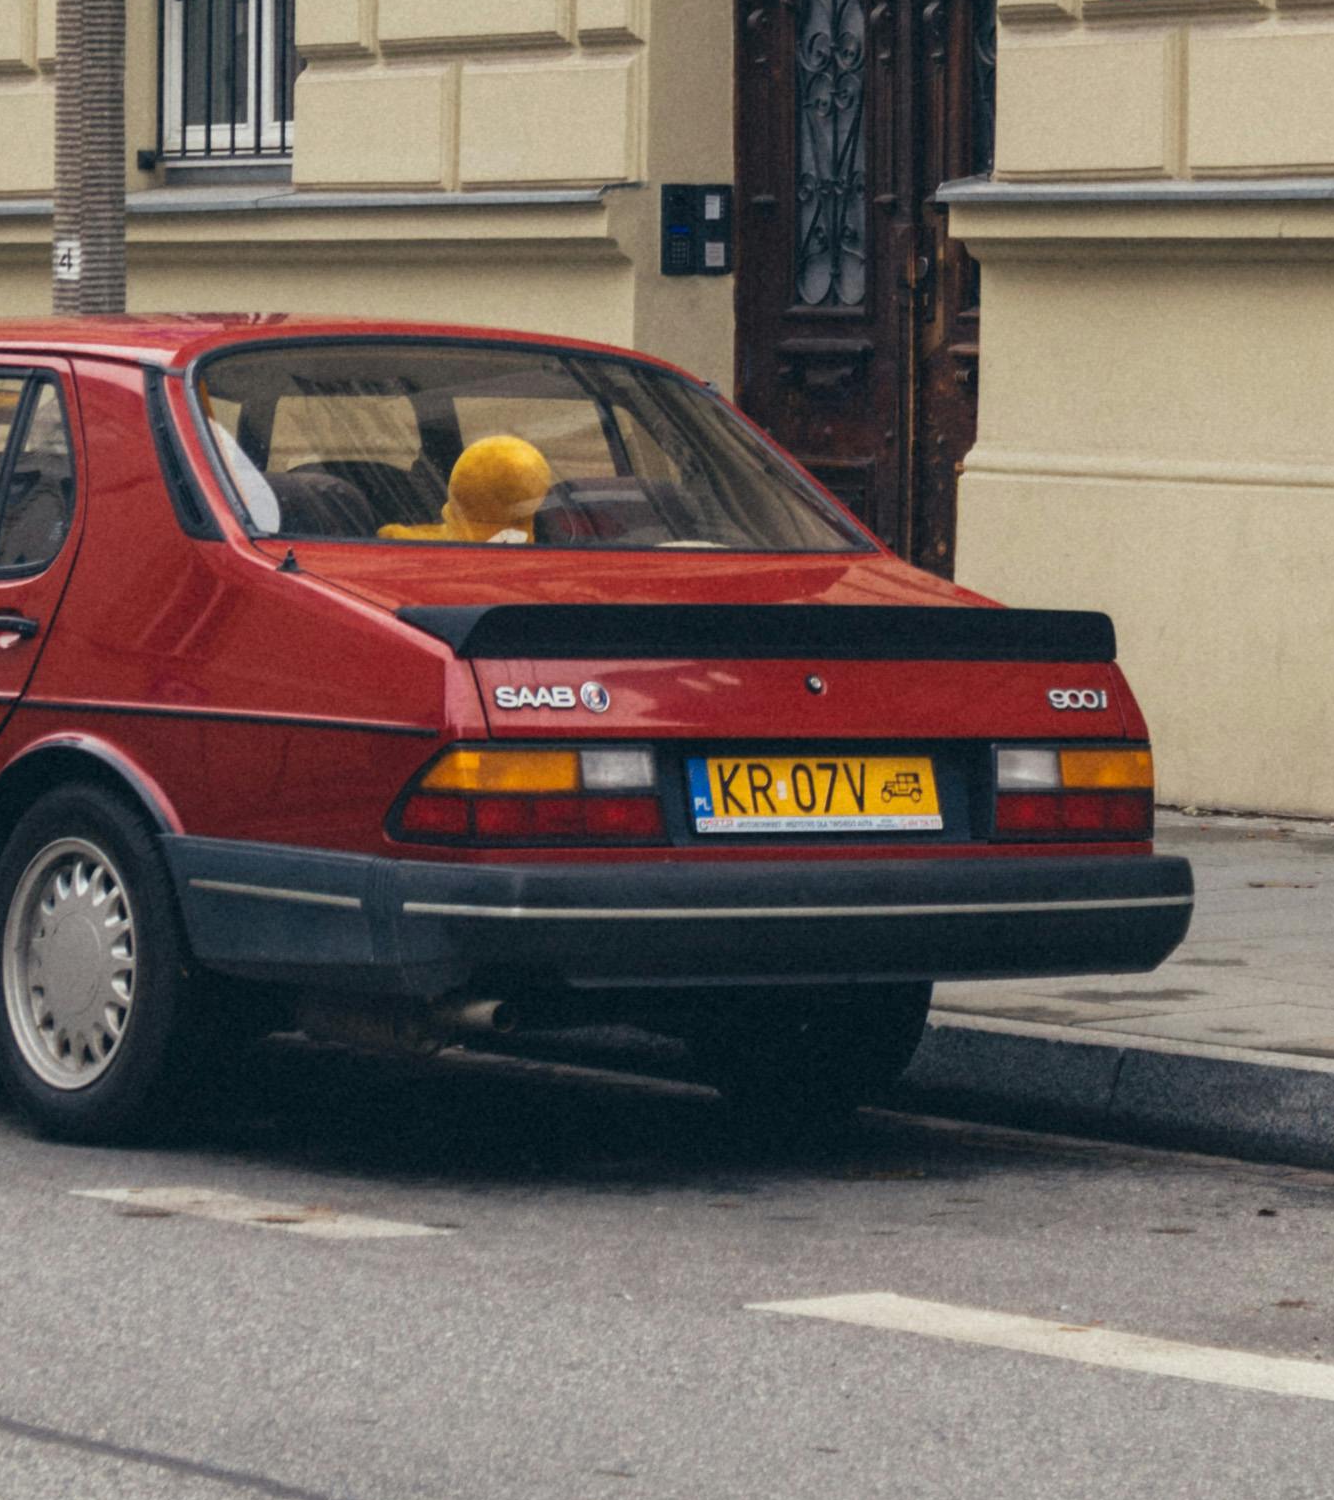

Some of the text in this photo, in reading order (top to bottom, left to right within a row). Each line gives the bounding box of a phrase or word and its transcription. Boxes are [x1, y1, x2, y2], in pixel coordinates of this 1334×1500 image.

[58, 247, 74, 272] 4
[495, 685, 577, 709] SAAB
[717, 762, 866, 815] KR 07V
[694, 796, 712, 812] PL
